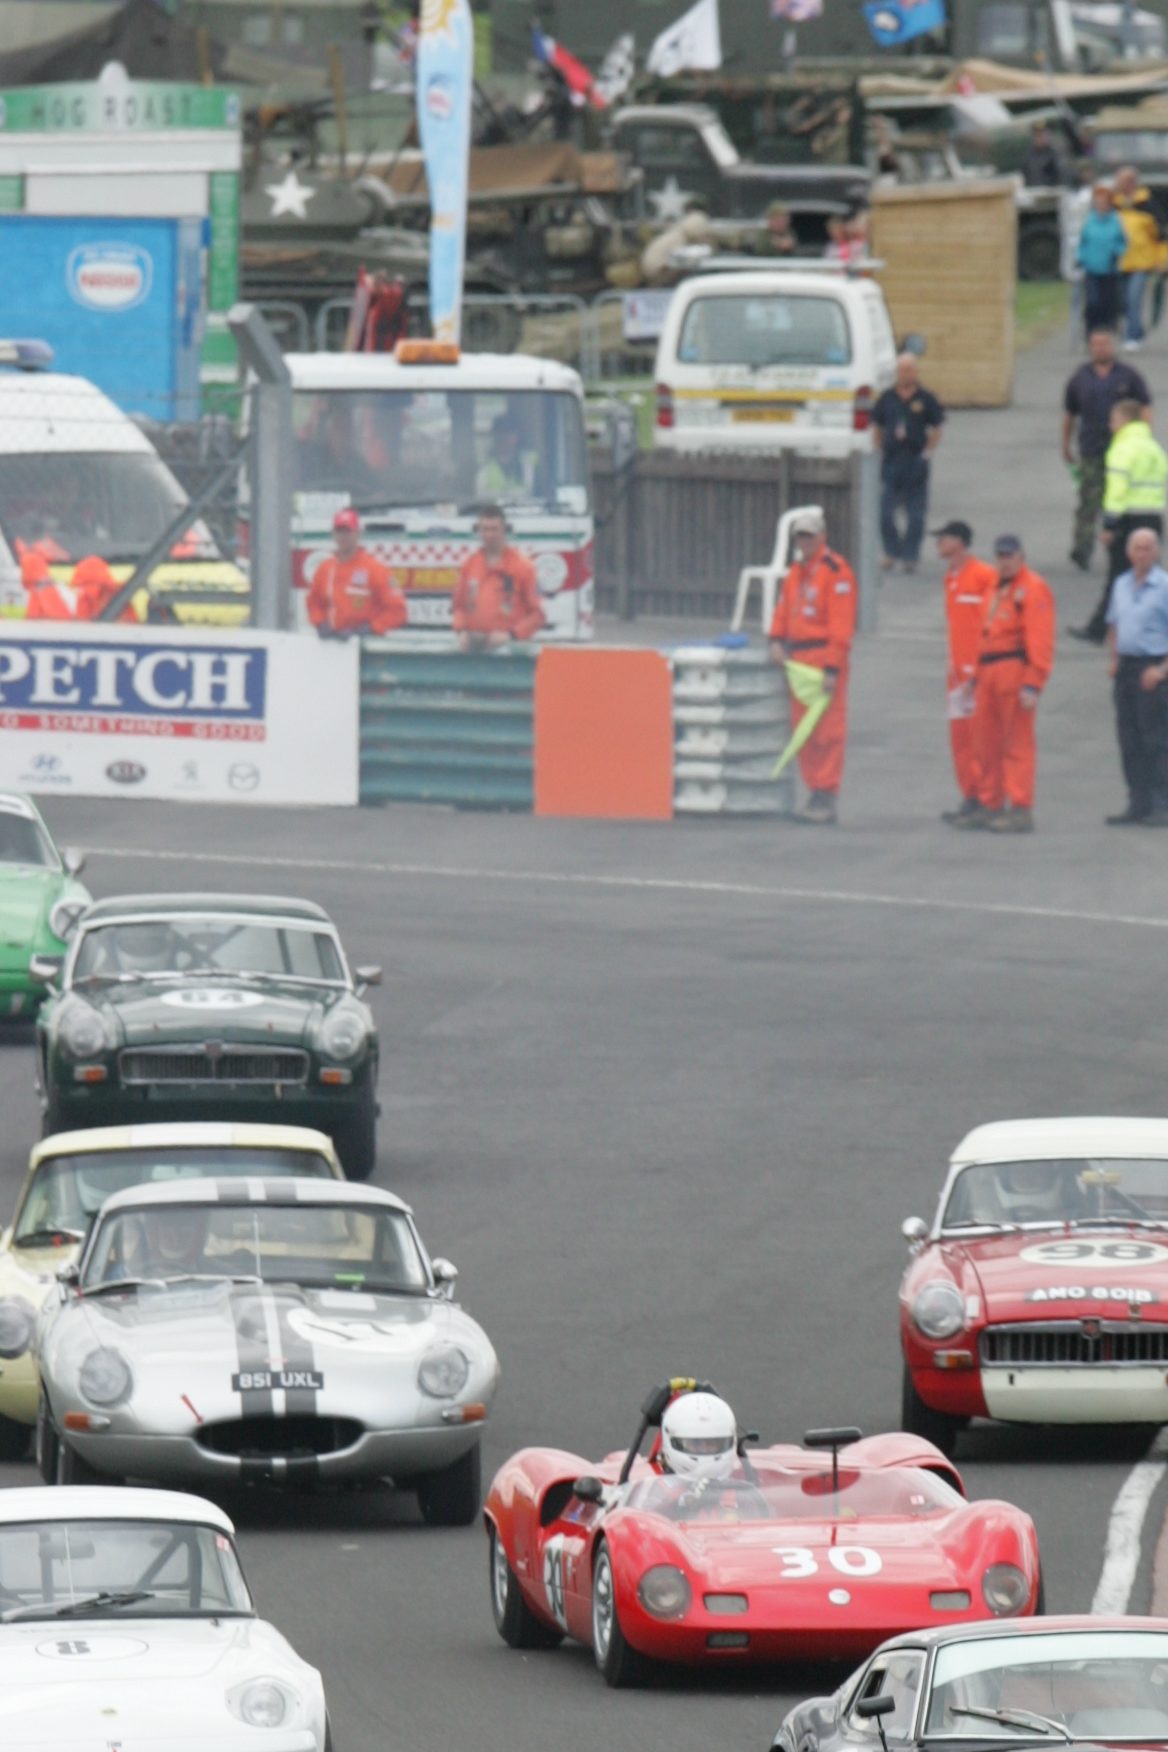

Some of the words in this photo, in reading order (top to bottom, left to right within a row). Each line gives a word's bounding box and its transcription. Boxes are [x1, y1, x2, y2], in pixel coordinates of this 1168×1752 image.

[31, 96, 86, 127] HOG
[104, 95, 193, 127] ROAST
[0, 646, 252, 709] PETCH
[38, 714, 176, 737] SOMETHING
[191, 723, 266, 742] GOOD
[1038, 1243, 1157, 1260] 98
[279, 1371, 321, 1389] UXL
[770, 1545, 883, 1578] 30
